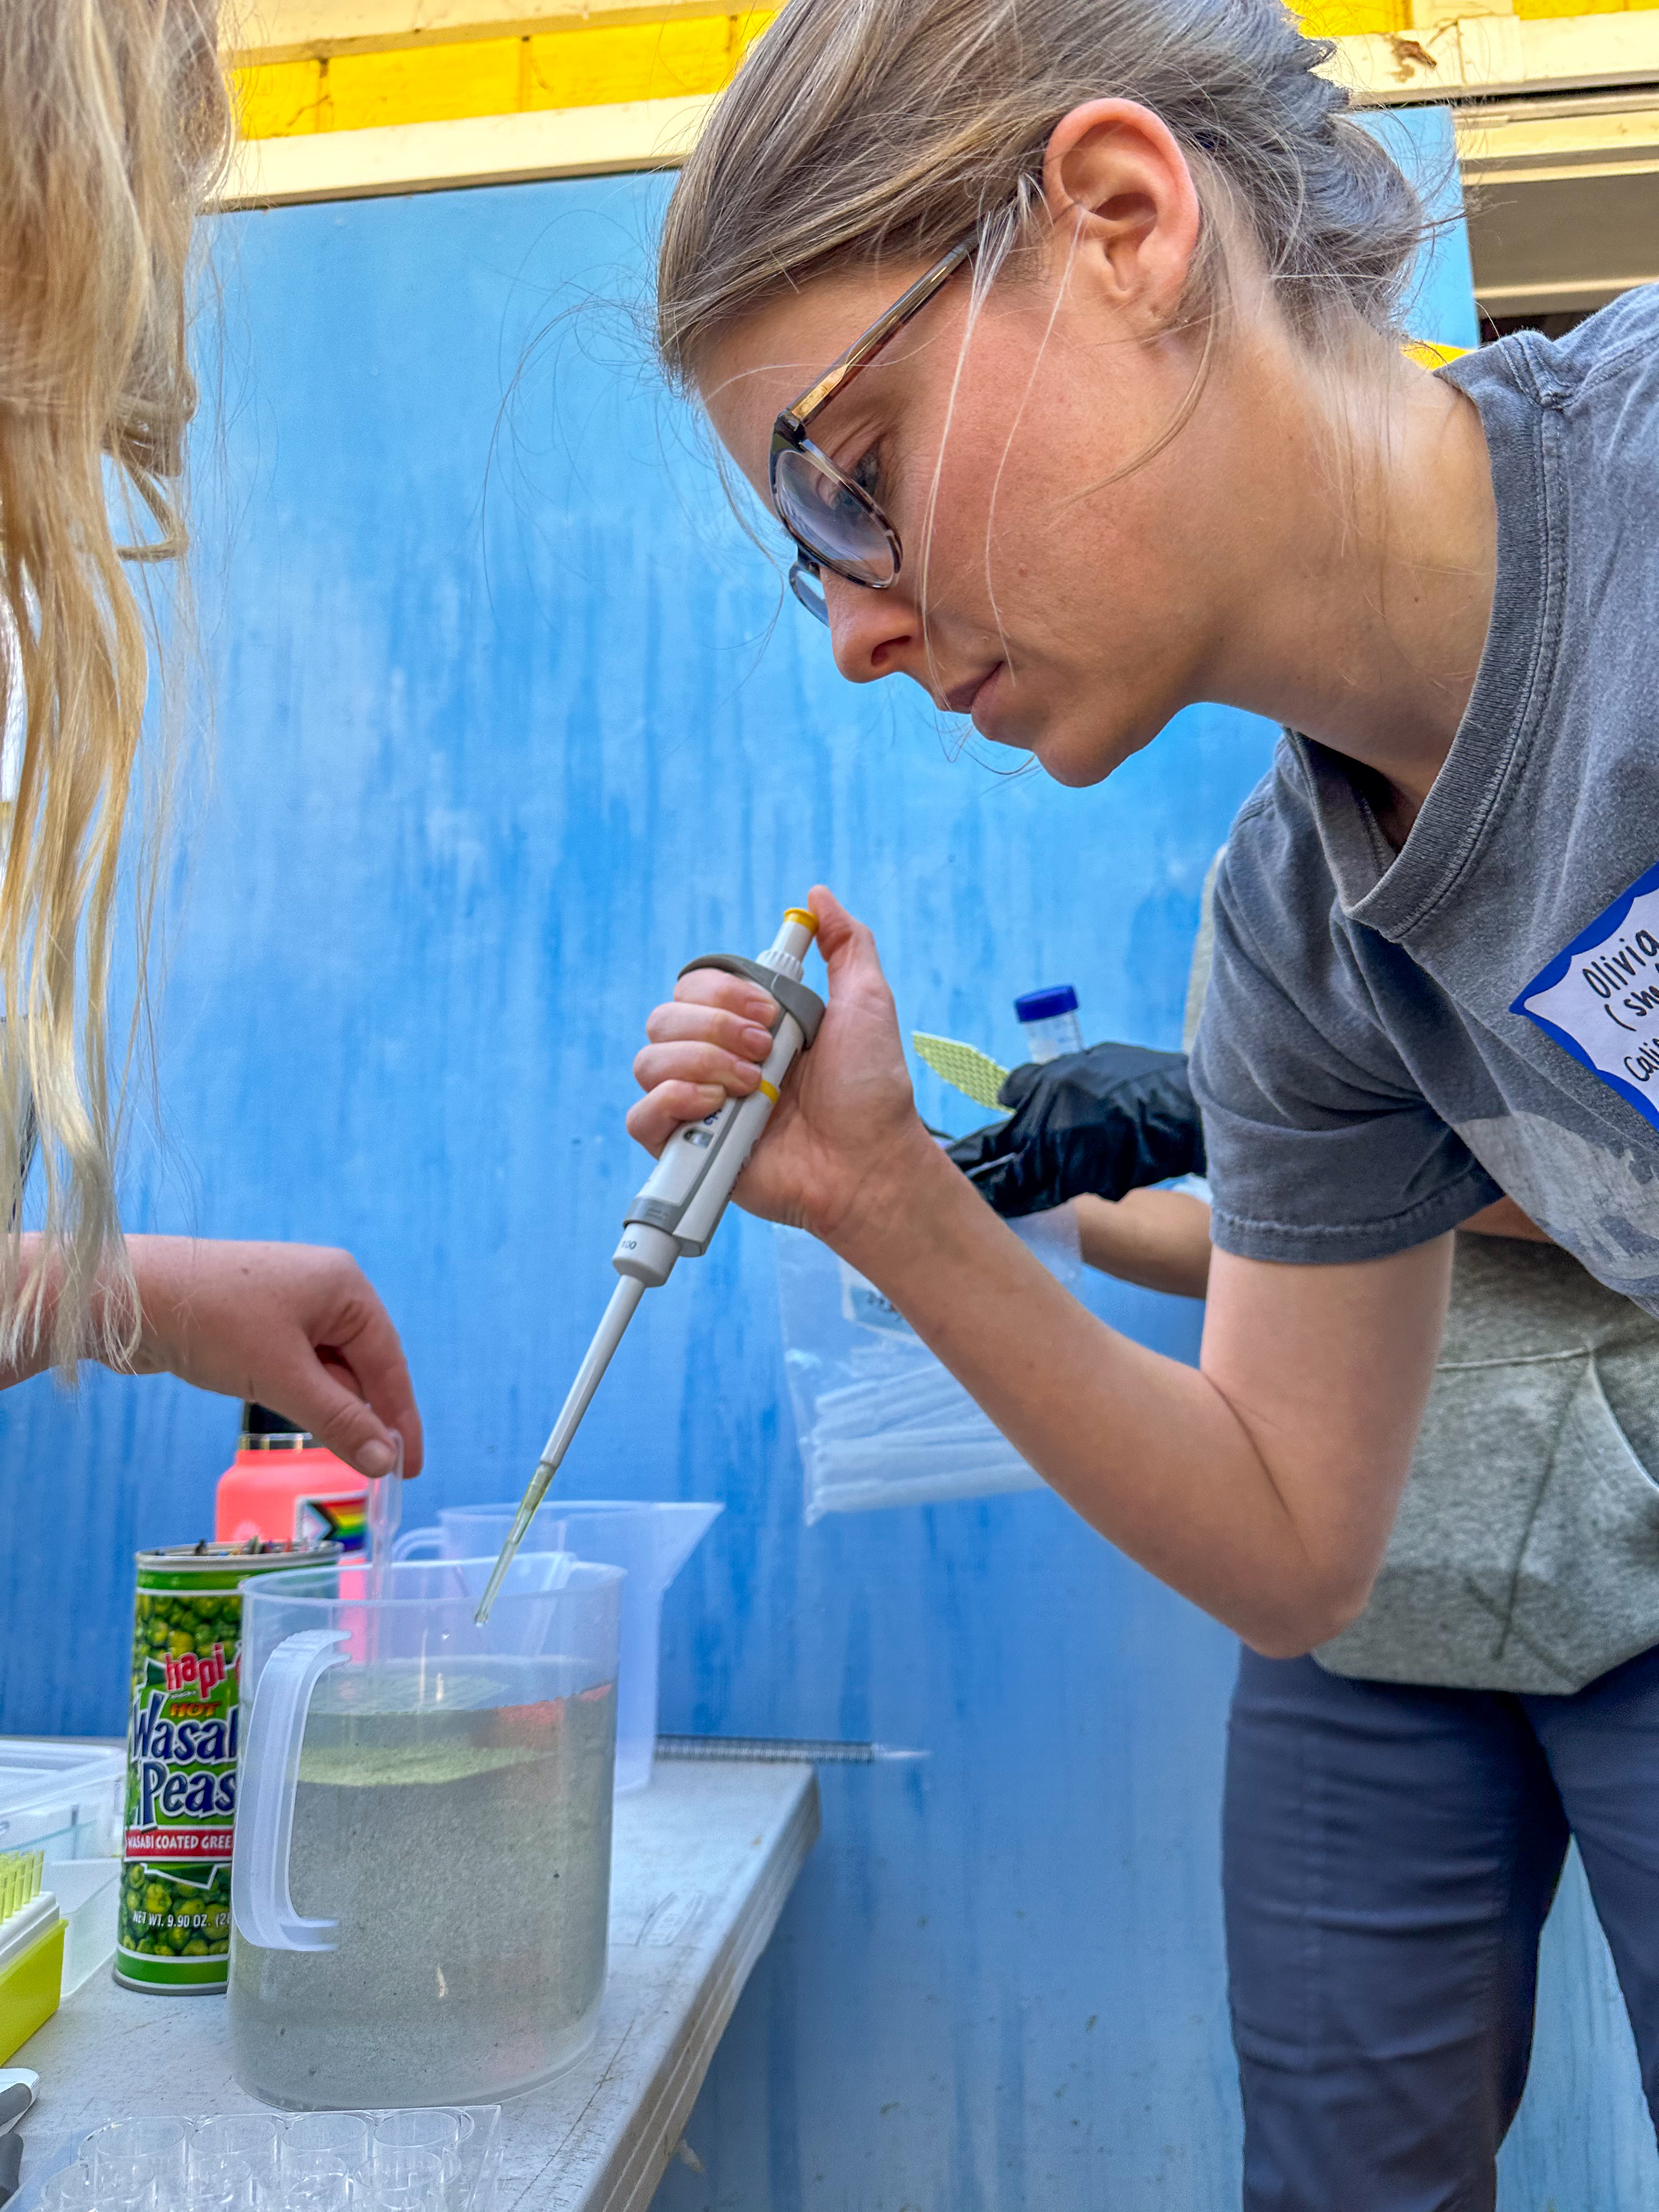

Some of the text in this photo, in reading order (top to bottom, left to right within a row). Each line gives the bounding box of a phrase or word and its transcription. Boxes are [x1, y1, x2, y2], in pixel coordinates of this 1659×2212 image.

[1582, 929, 1659, 998] Olivia
[1624, 1038, 1659, 1082] Cali
[165, 1642, 227, 1700] hapi
[170, 1702, 221, 1718] HOT
[142, 1760, 237, 1826] Peas
[127, 1835, 155, 1849] WASABI
[156, 1835, 199, 1849] COATED
[133, 1910, 147, 1924] NET
[149, 1912, 165, 1927] WT.
[167, 1914, 190, 1928] 9.90
